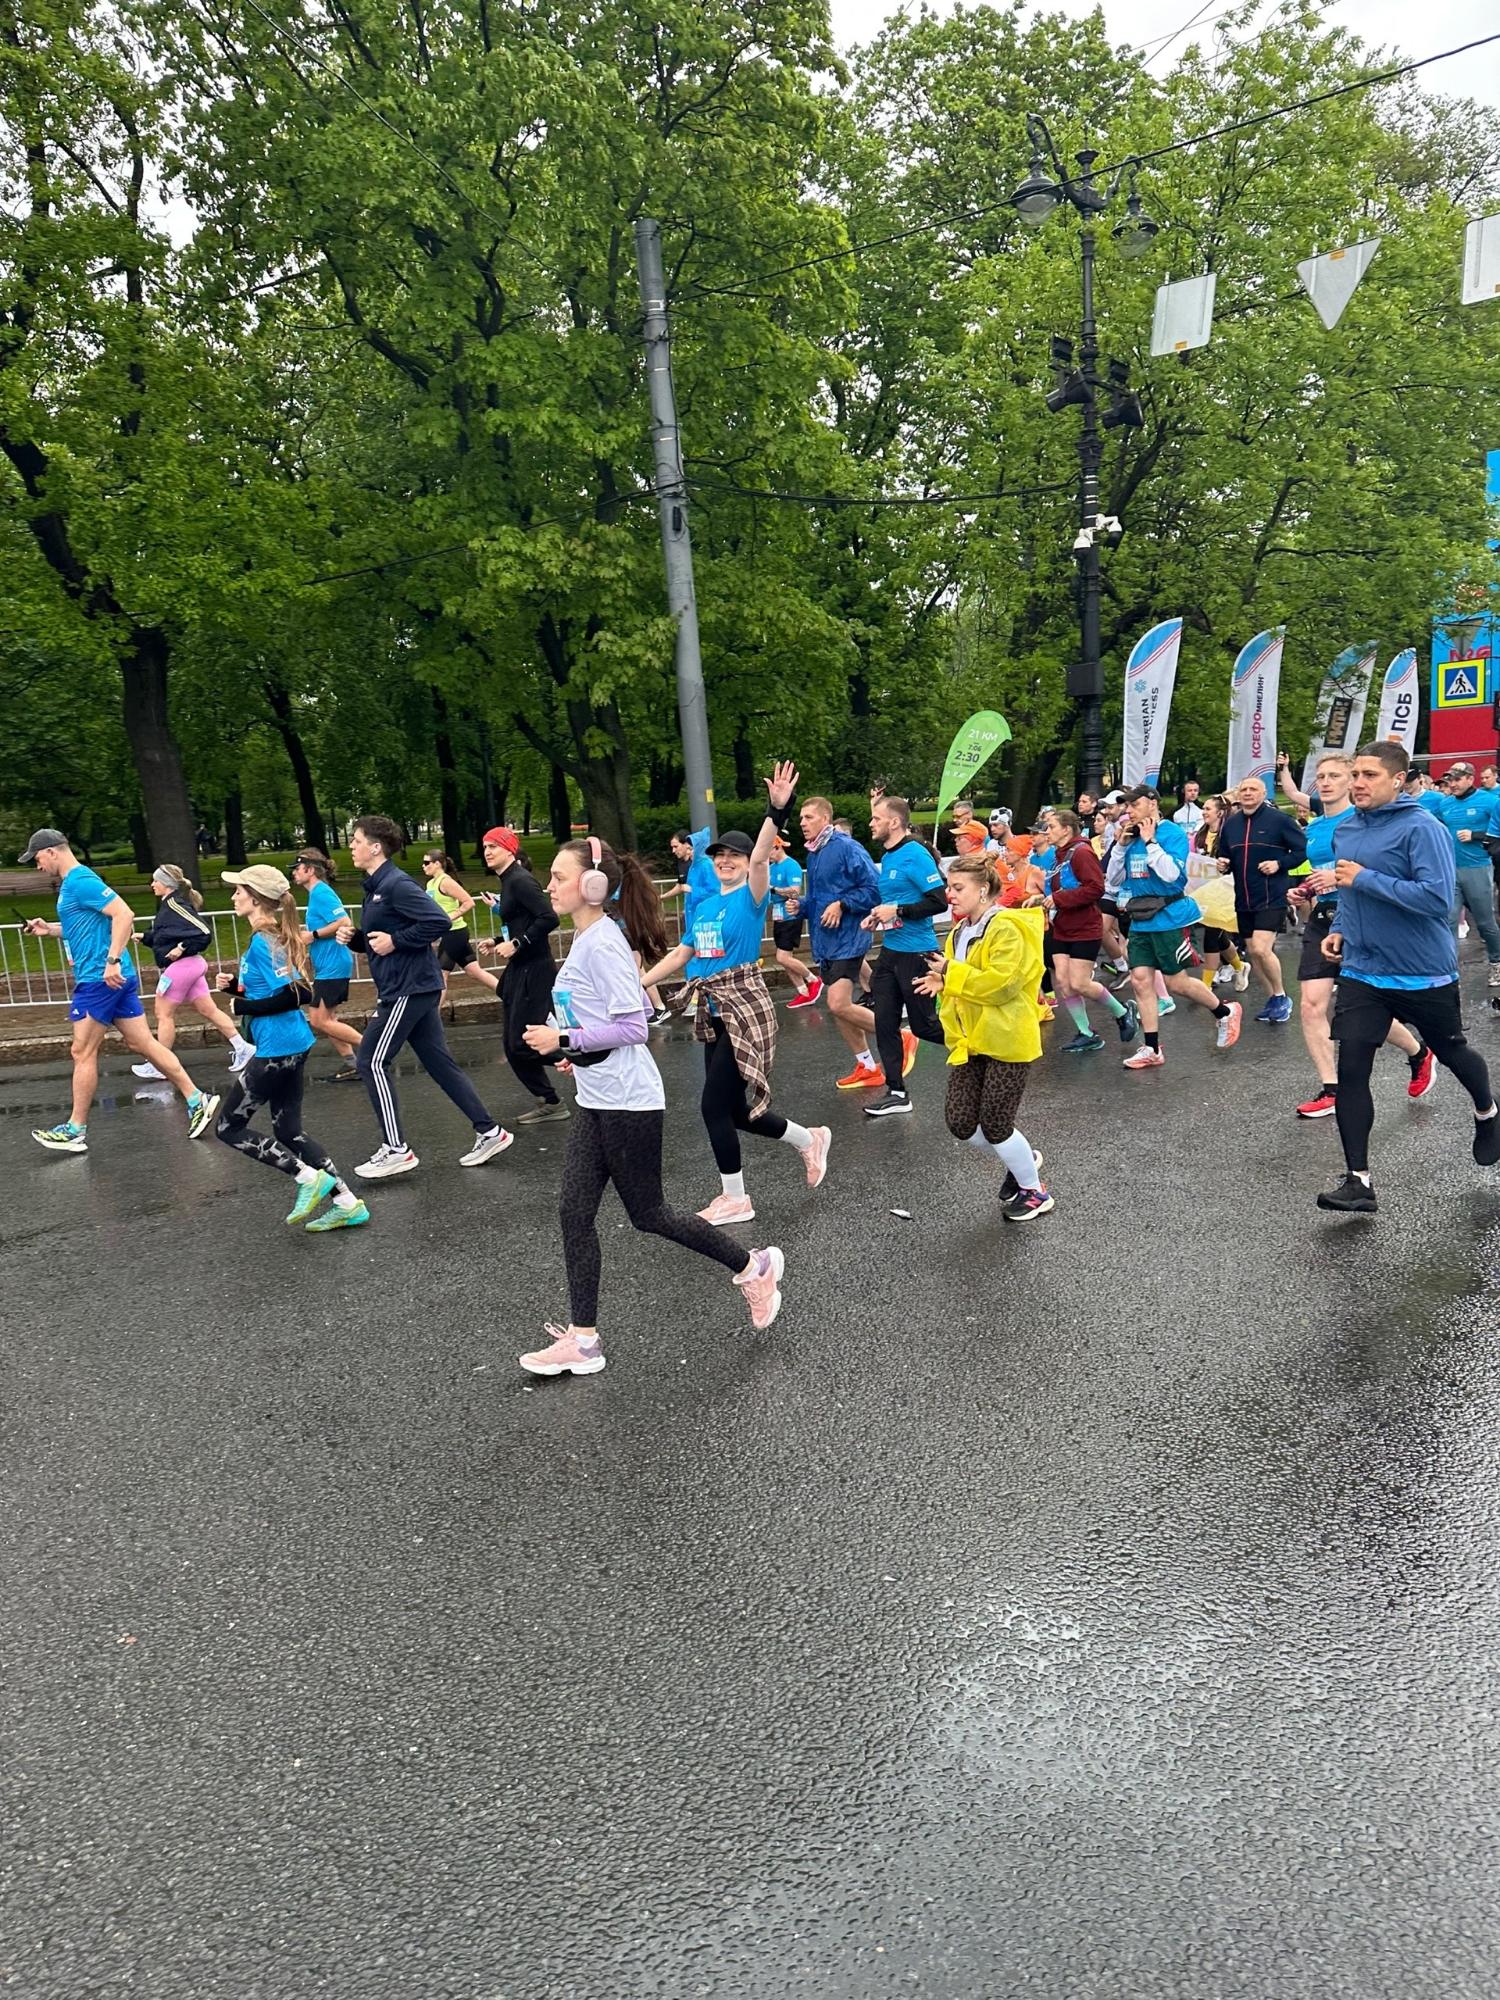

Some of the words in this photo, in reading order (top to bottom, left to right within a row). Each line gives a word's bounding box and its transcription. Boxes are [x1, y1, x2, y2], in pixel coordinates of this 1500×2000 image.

[1391, 693, 1412, 732] ПСБ
[969, 729, 979, 739] 21
[955, 750, 980, 763] 2:30
